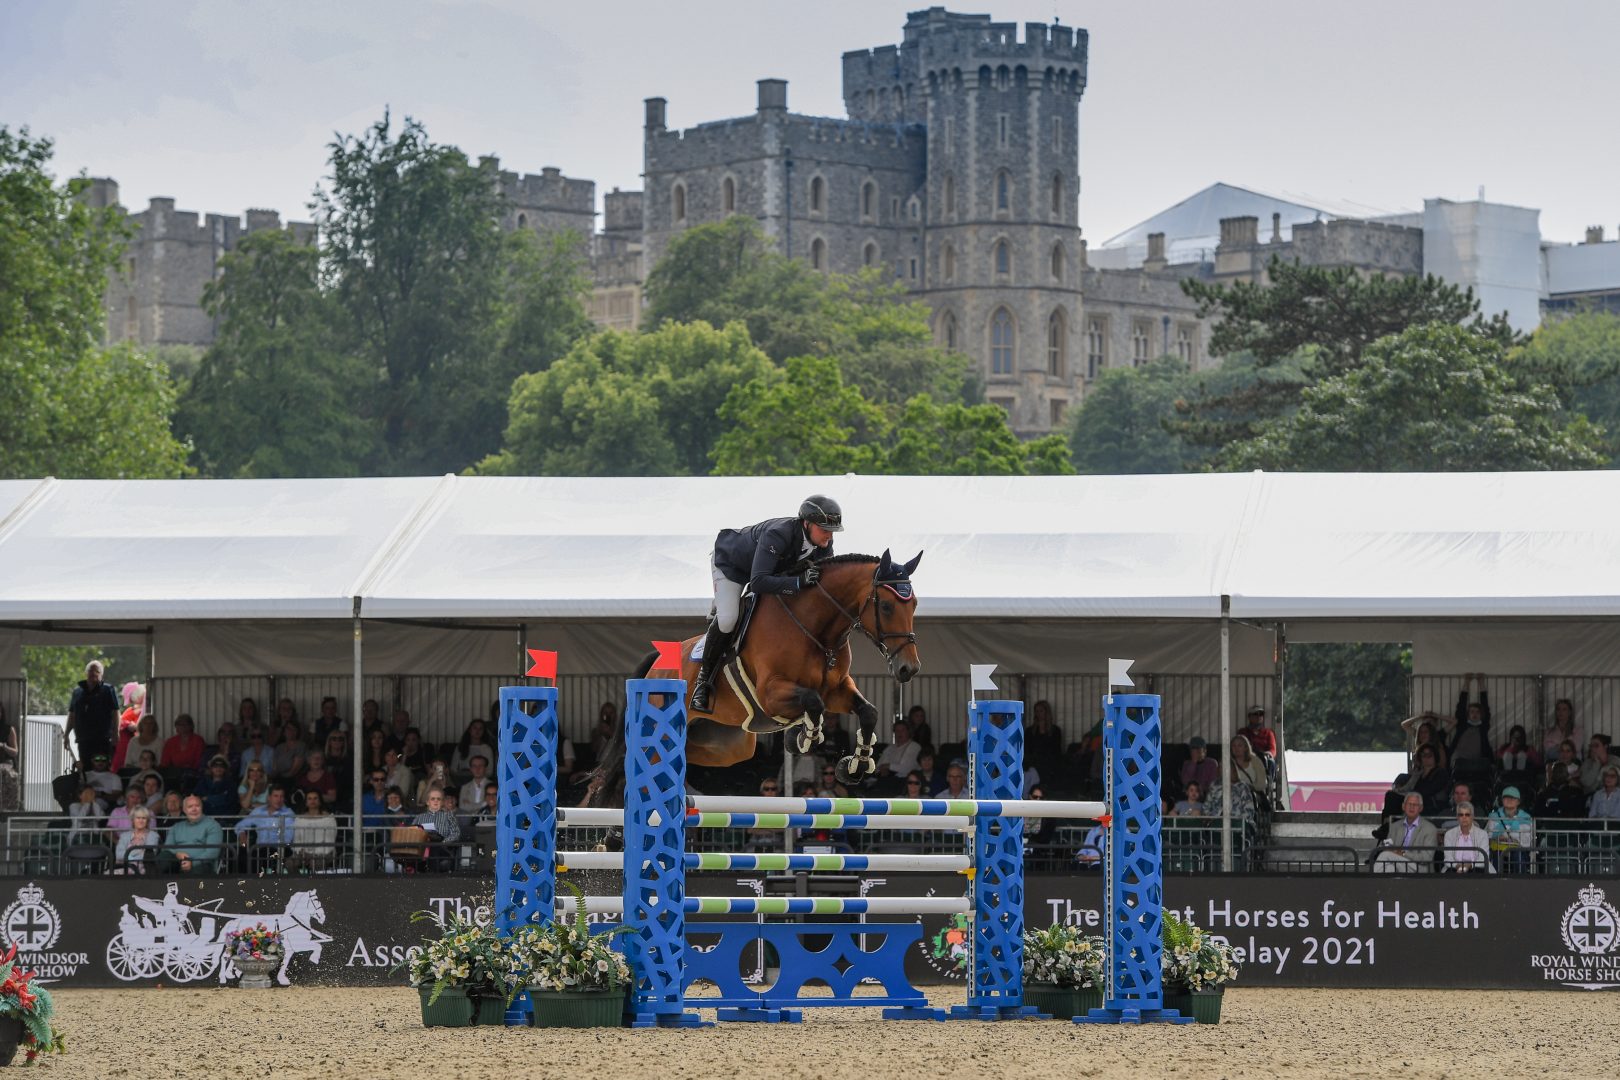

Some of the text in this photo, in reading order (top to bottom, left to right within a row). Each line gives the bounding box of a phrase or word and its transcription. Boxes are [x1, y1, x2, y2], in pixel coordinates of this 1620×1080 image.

[429, 897, 491, 928] The
[1047, 899, 1100, 926] The
[1209, 899, 1310, 928] Horses
[1321, 900, 1365, 928] for
[1378, 901, 1479, 929] Health
[18, 952, 90, 965] WINDSOR
[1302, 937, 1376, 965] 2021
[34, 965, 77, 977] SHOW
[1531, 955, 1576, 968] ROYAL
[1544, 968, 1592, 981] HORSE
